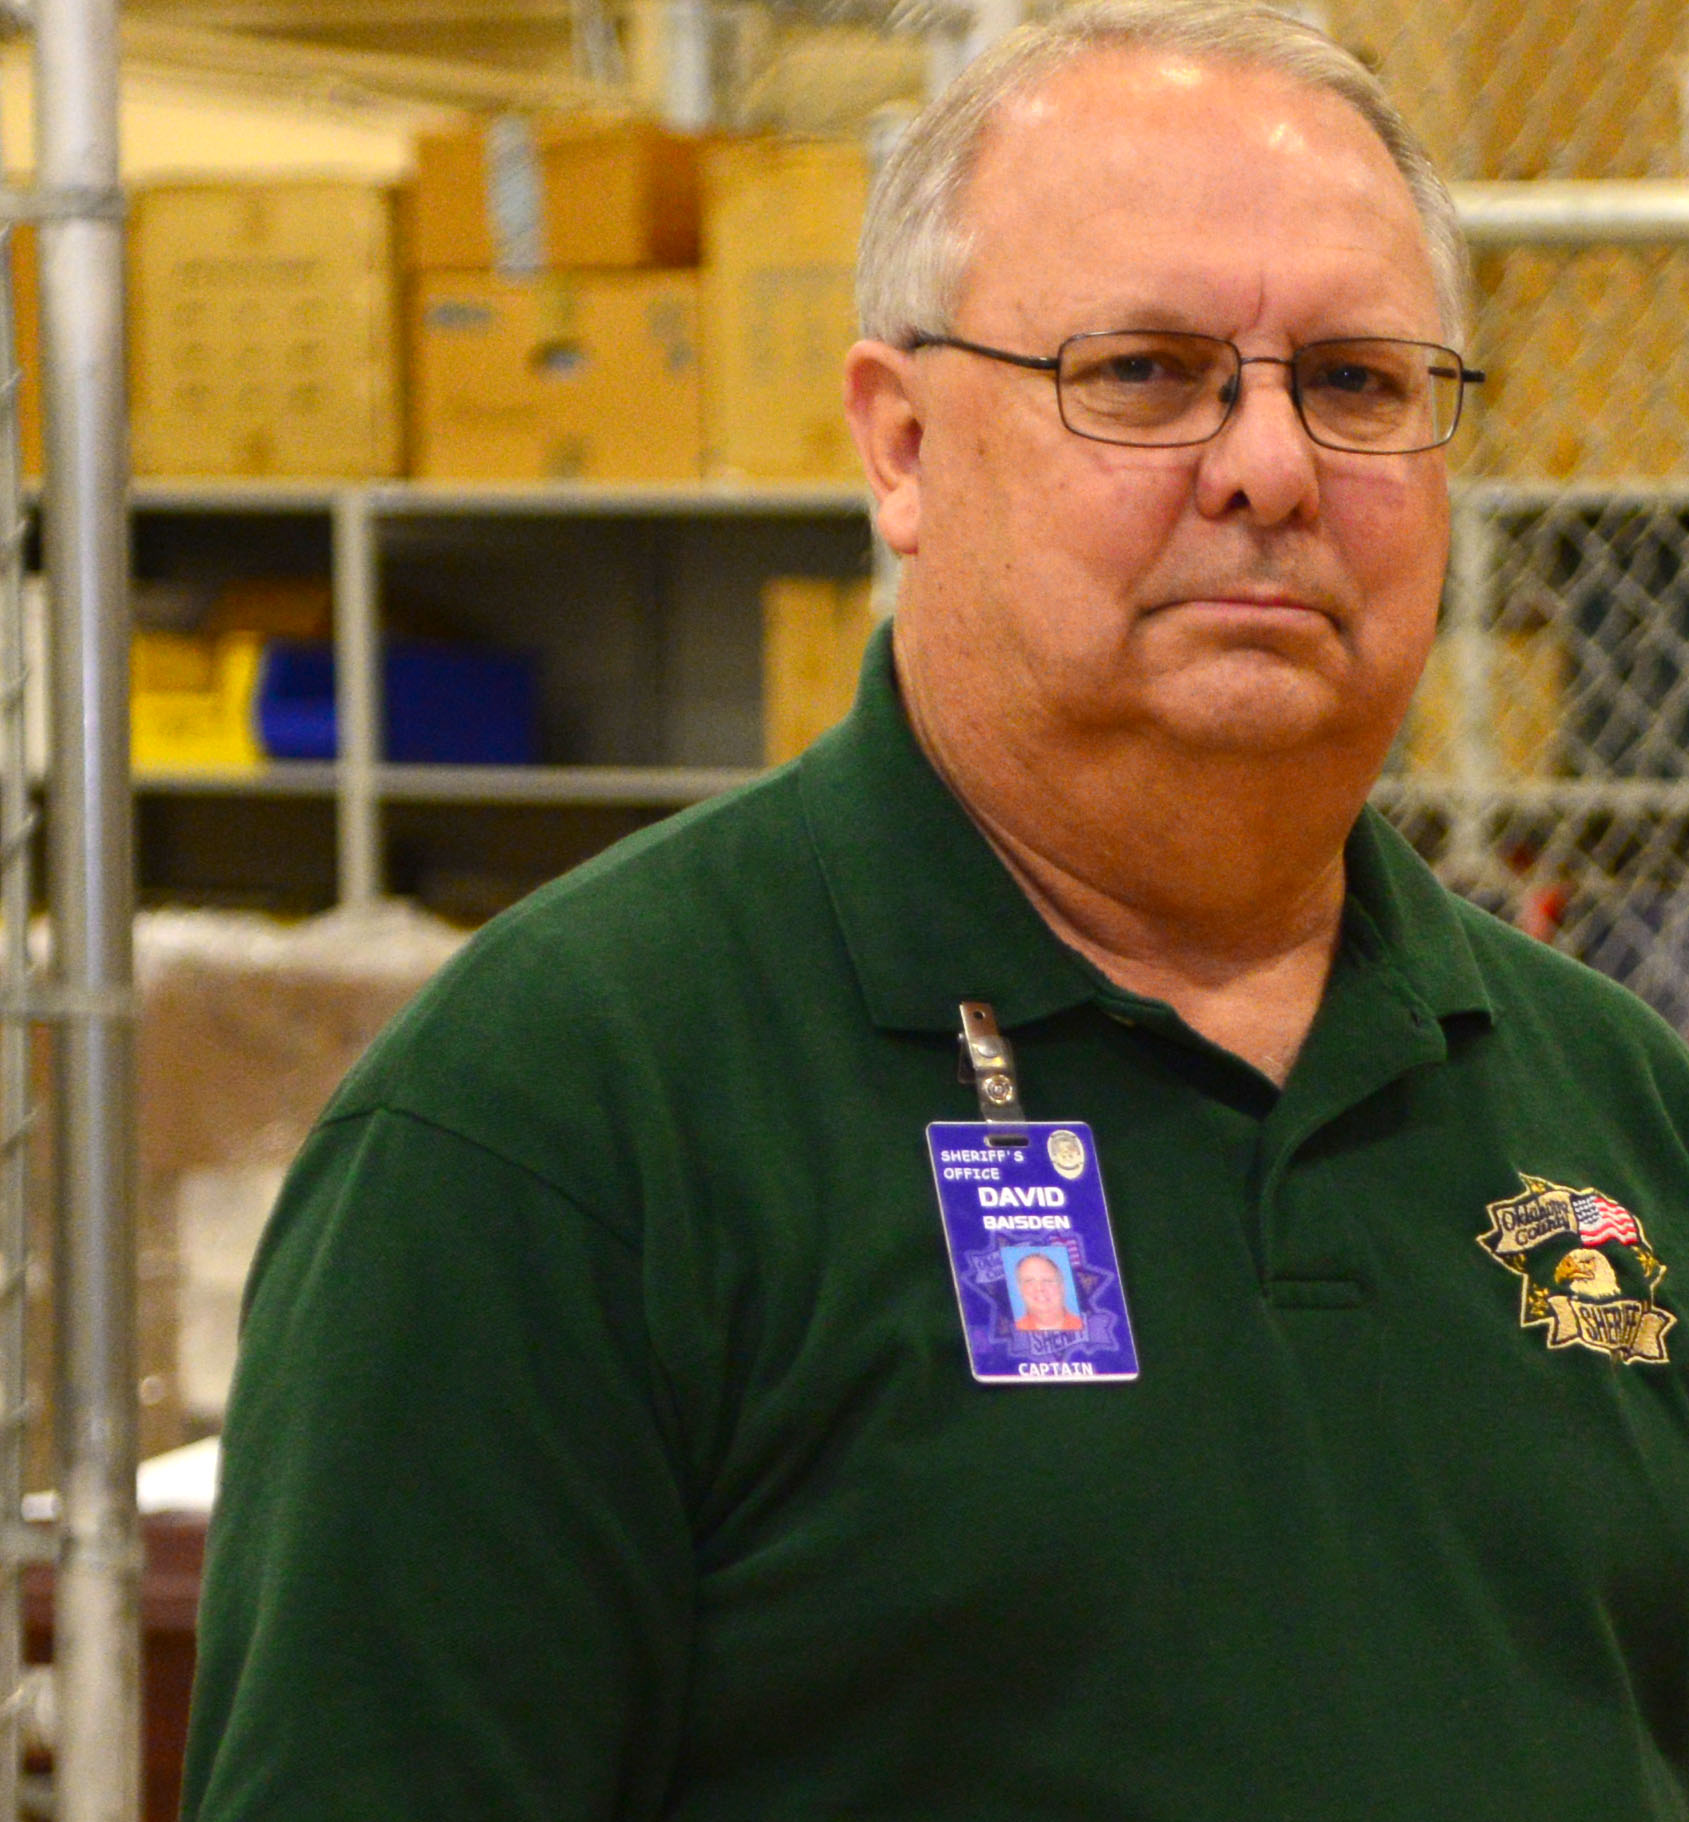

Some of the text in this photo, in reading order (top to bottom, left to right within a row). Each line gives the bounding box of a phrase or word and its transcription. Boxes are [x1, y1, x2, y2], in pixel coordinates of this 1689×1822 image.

[941, 1150, 1024, 1162] SHERIFF'S
[943, 1167, 1000, 1180] OFFICE
[978, 1186, 1065, 1207] DAVID
[983, 1215, 1071, 1230] BAISDEN
[1018, 1362, 1094, 1375] CAPTAIN
